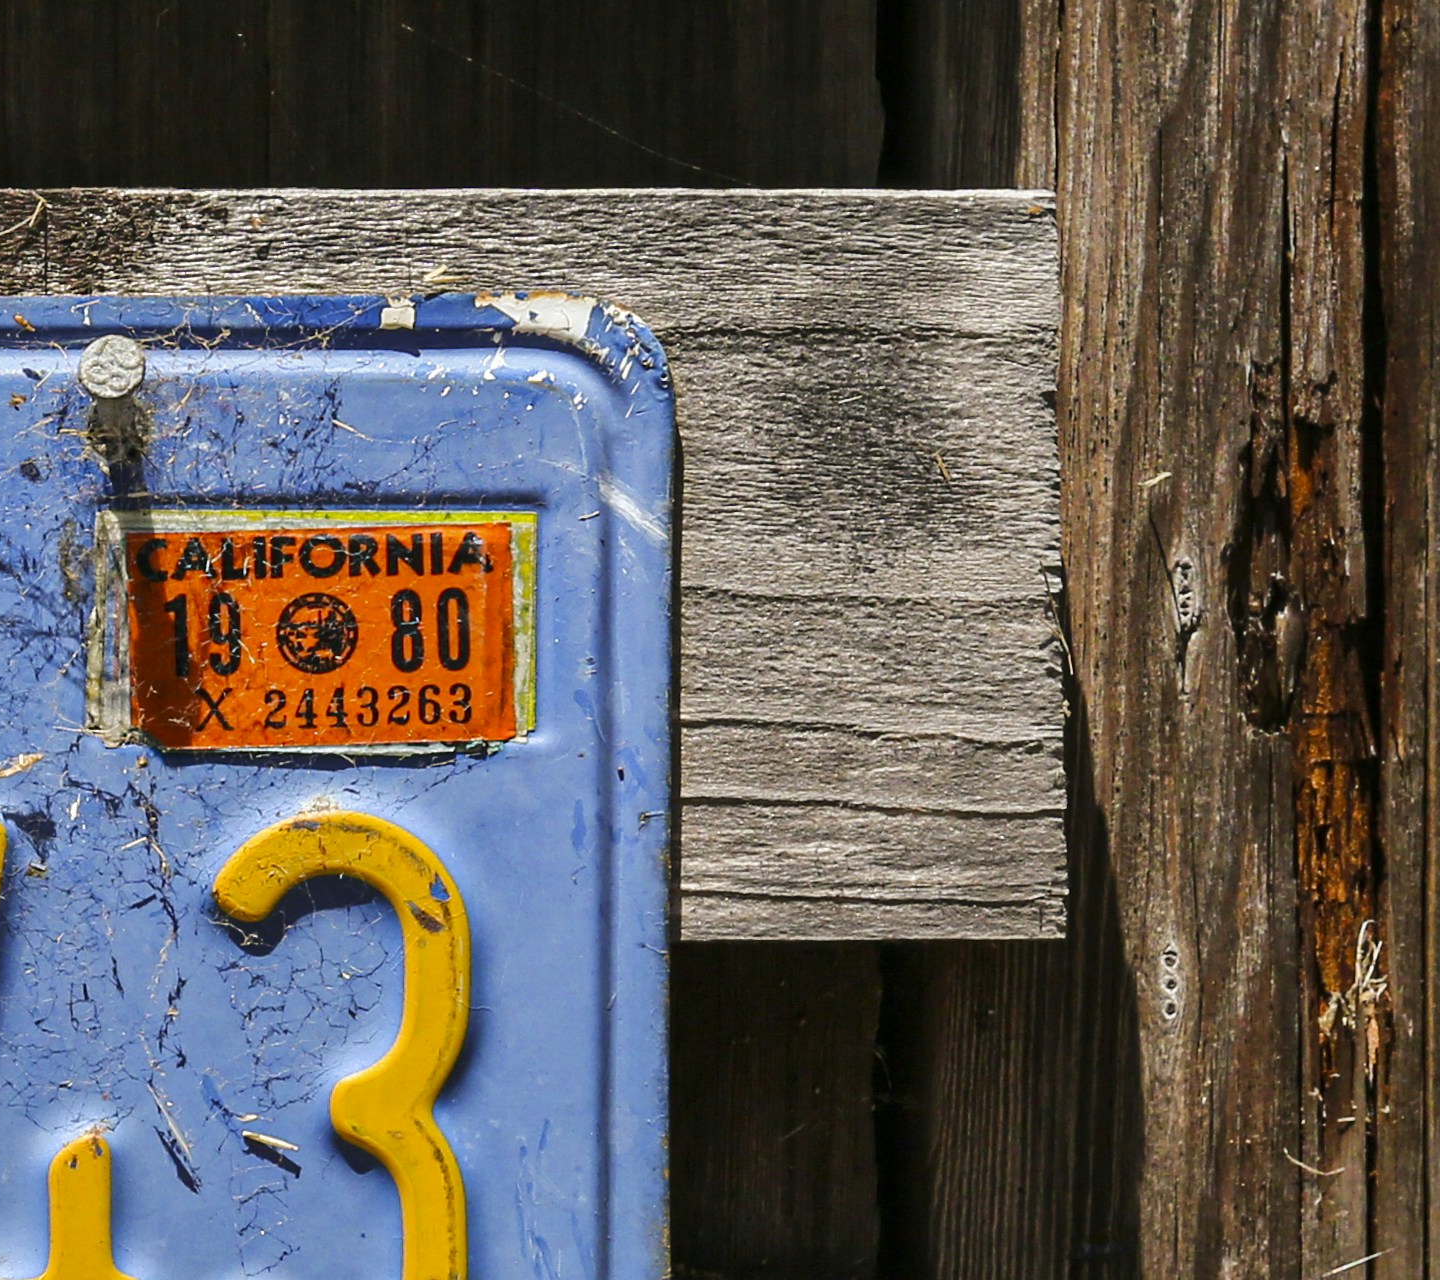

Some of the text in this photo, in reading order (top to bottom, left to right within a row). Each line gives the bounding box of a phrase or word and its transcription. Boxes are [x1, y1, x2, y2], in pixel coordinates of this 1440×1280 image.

[135, 531, 494, 583] CALIFORNIA
[164, 590, 241, 678] 19
[390, 587, 471, 673] 80
[195, 682, 473, 732] X 2443263
